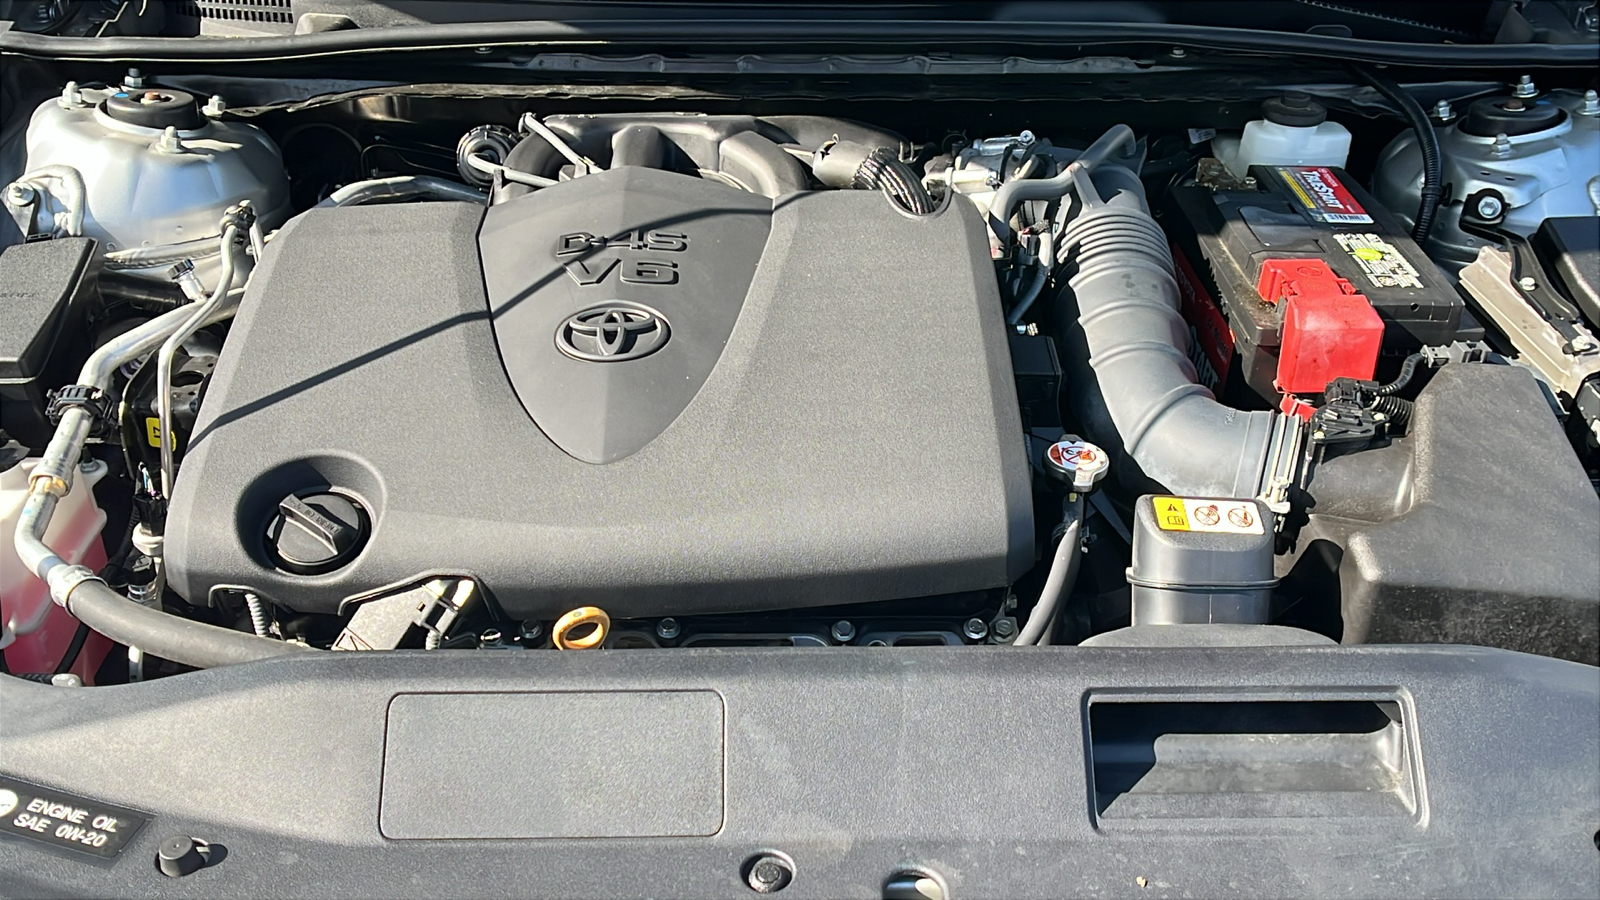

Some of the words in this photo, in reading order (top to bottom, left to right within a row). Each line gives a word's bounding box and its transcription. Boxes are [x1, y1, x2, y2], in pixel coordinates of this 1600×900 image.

[563, 258, 680, 286] V6
[13, 812, 52, 833] SAE
[55, 824, 108, 848] 0W-20
[26, 797, 90, 824] ENGINE
[92, 814, 119, 833] OIL
